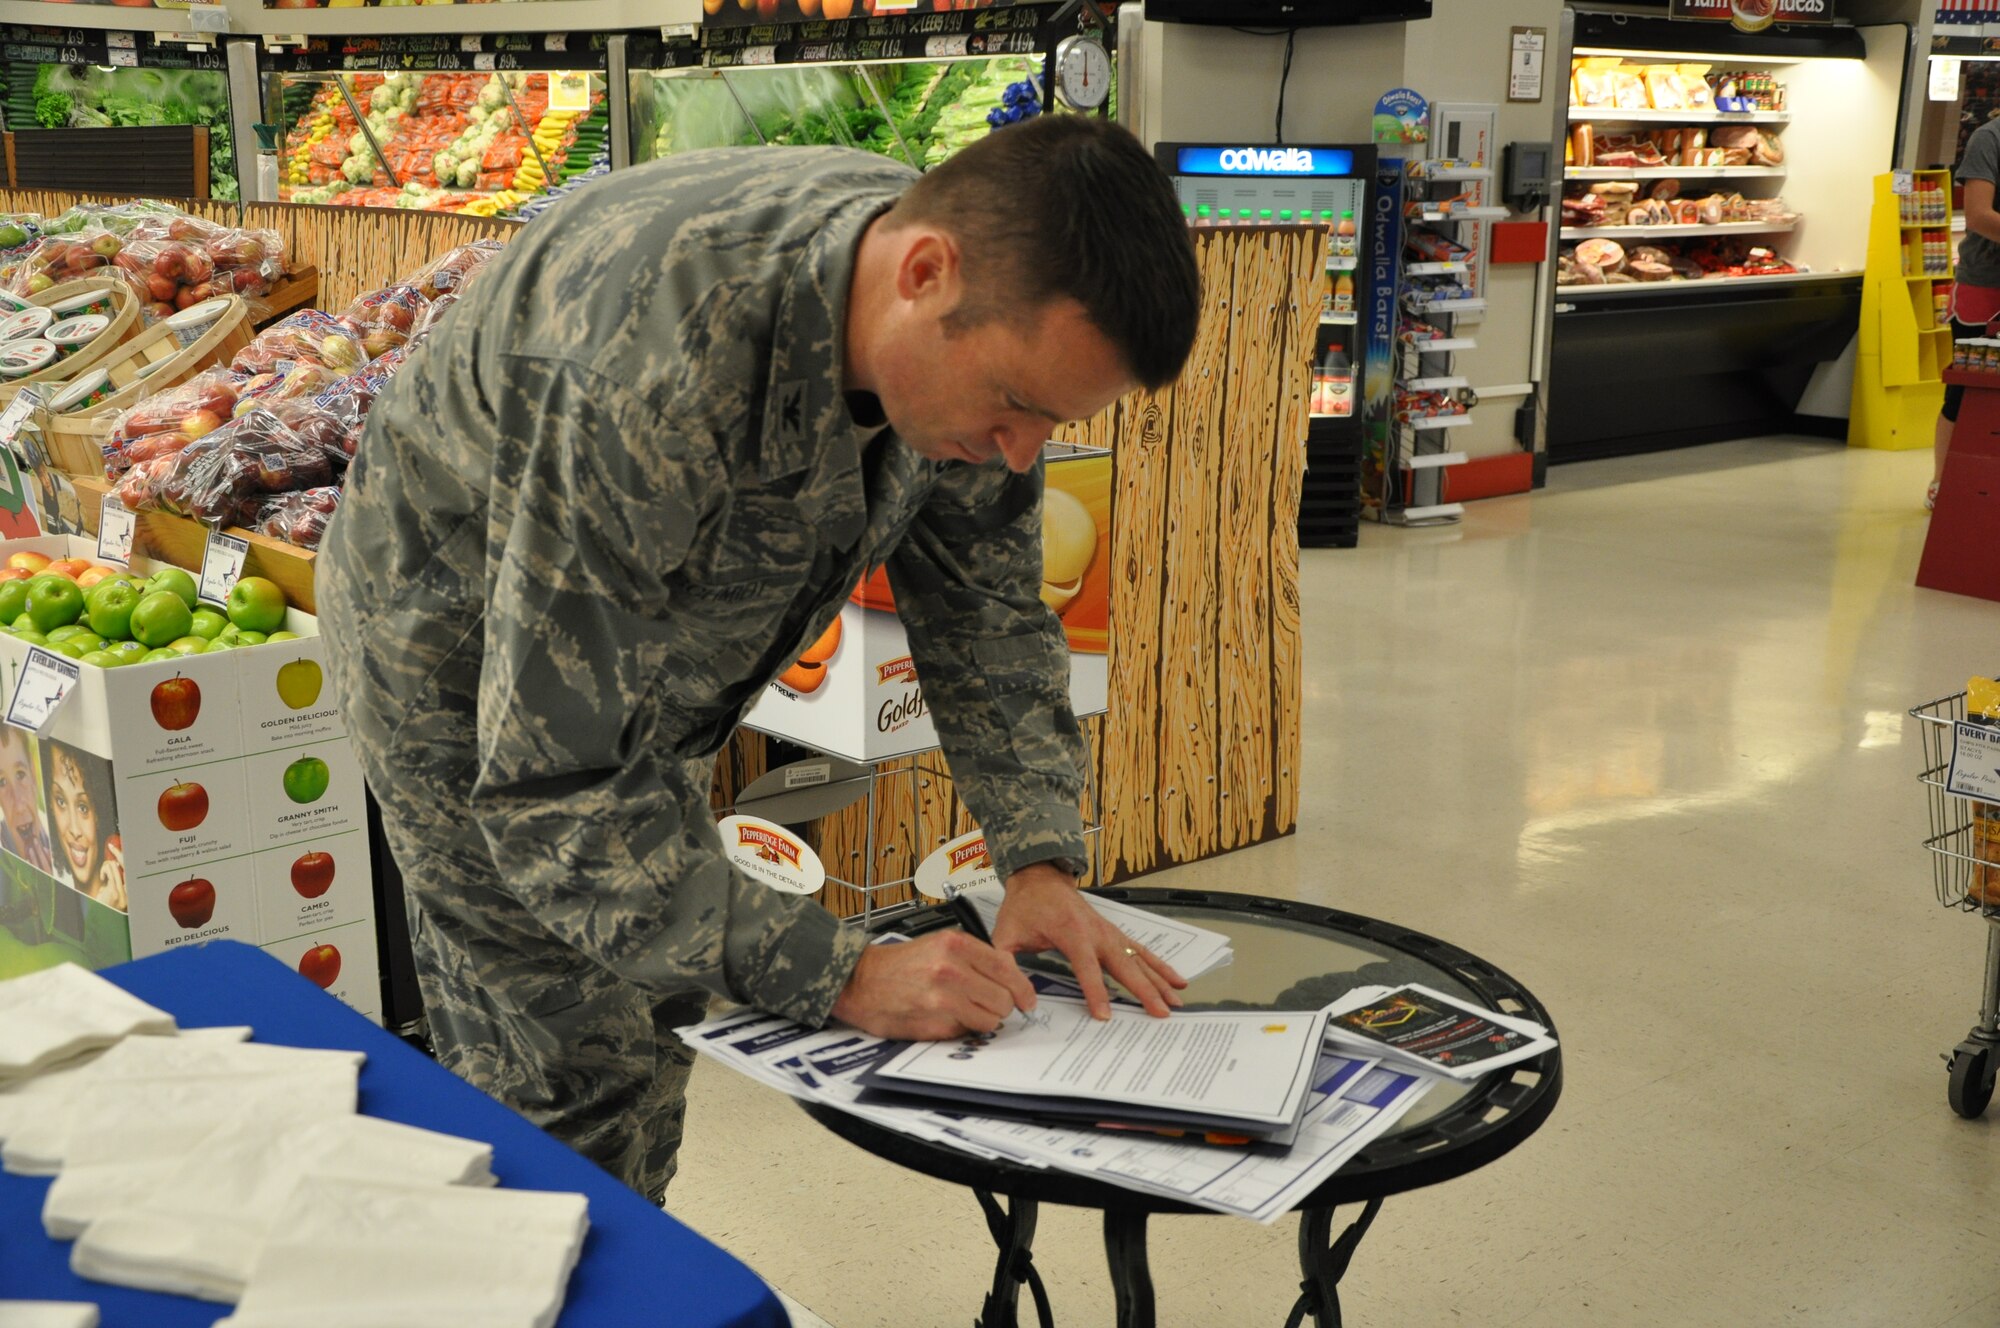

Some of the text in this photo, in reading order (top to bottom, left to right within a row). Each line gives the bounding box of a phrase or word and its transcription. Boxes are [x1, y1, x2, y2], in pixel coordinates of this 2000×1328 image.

[60, 48, 78, 62] .69
[196, 54, 220, 68] 1.09
[1219, 148, 1315, 172] odwalla
[1374, 196, 1393, 339] Odwalla Bars!
[884, 660, 914, 678] PEPPERI
[260, 708, 338, 729] GOLDEN DELICIOUS
[878, 688, 923, 732] Goldf
[168, 736, 192, 745] GALA
[1960, 726, 2000, 744] EVERY DA
[278, 805, 338, 823] GRANNY SMITH
[178, 835, 196, 844] FUJI
[742, 827, 796, 860] PEPPERIDGE FARM
[956, 842, 987, 865] PEPPERI
[734, 855, 750, 868] GOOD
[758, 866, 765, 874] IN
[766, 869, 778, 880] THE
[968, 880, 977, 888] IS
[300, 900, 330, 913] CAMEO
[164, 936, 182, 946] RED
[184, 925, 230, 942] DELICIOUS
